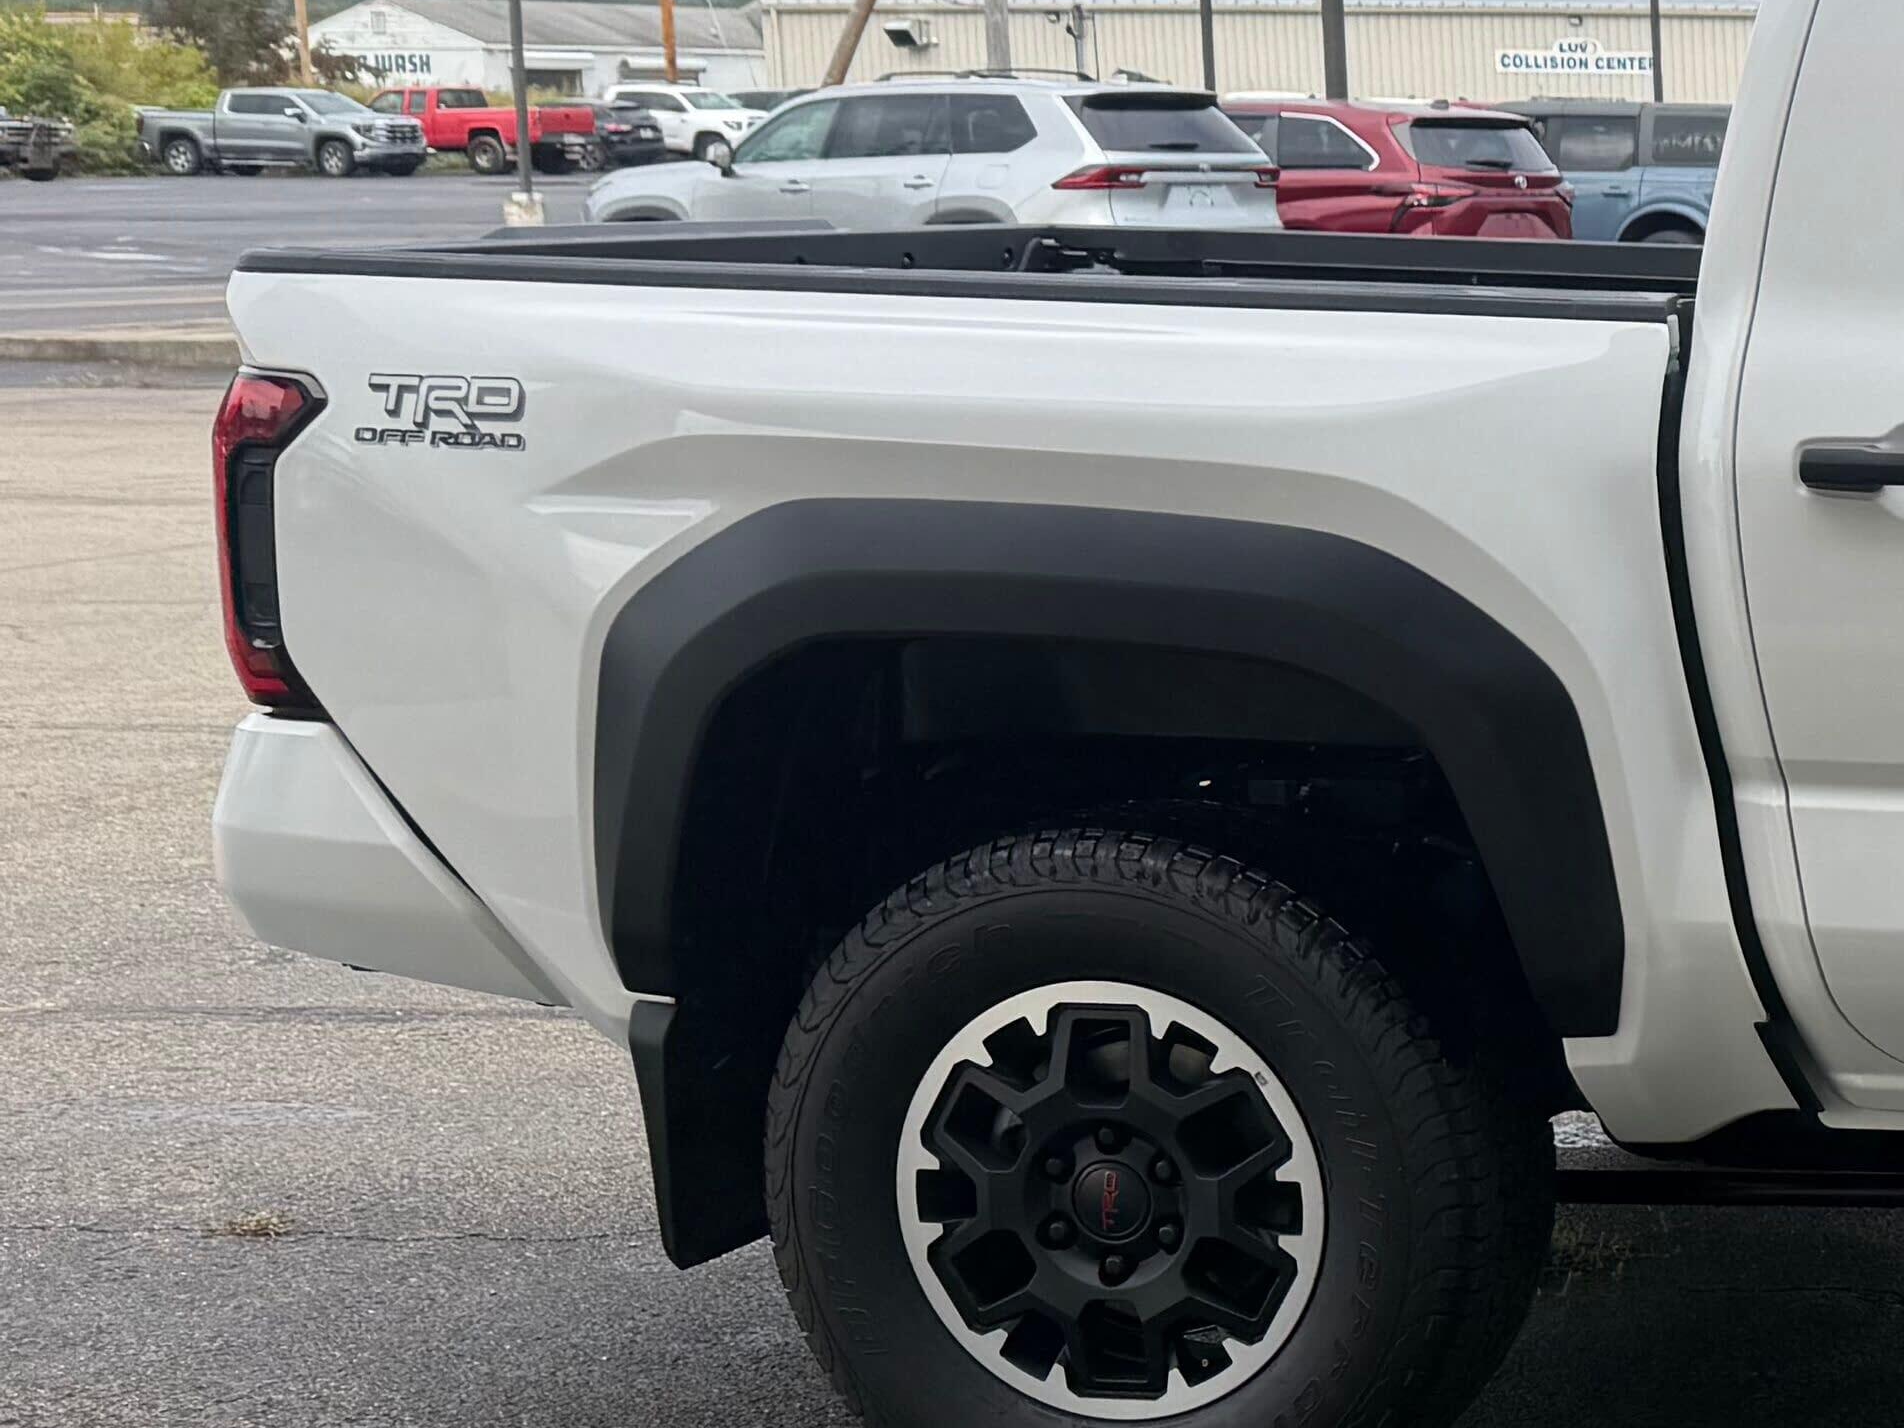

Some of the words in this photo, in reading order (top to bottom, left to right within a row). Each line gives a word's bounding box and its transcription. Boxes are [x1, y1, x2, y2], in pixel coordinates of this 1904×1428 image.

[374, 53, 431, 73] WASH
[1501, 53, 1589, 70] COLLISION
[368, 372, 527, 434] TRD
[354, 427, 426, 446] OFF
[430, 430, 526, 451] ROAD
[1103, 1171, 1120, 1230] TRD
